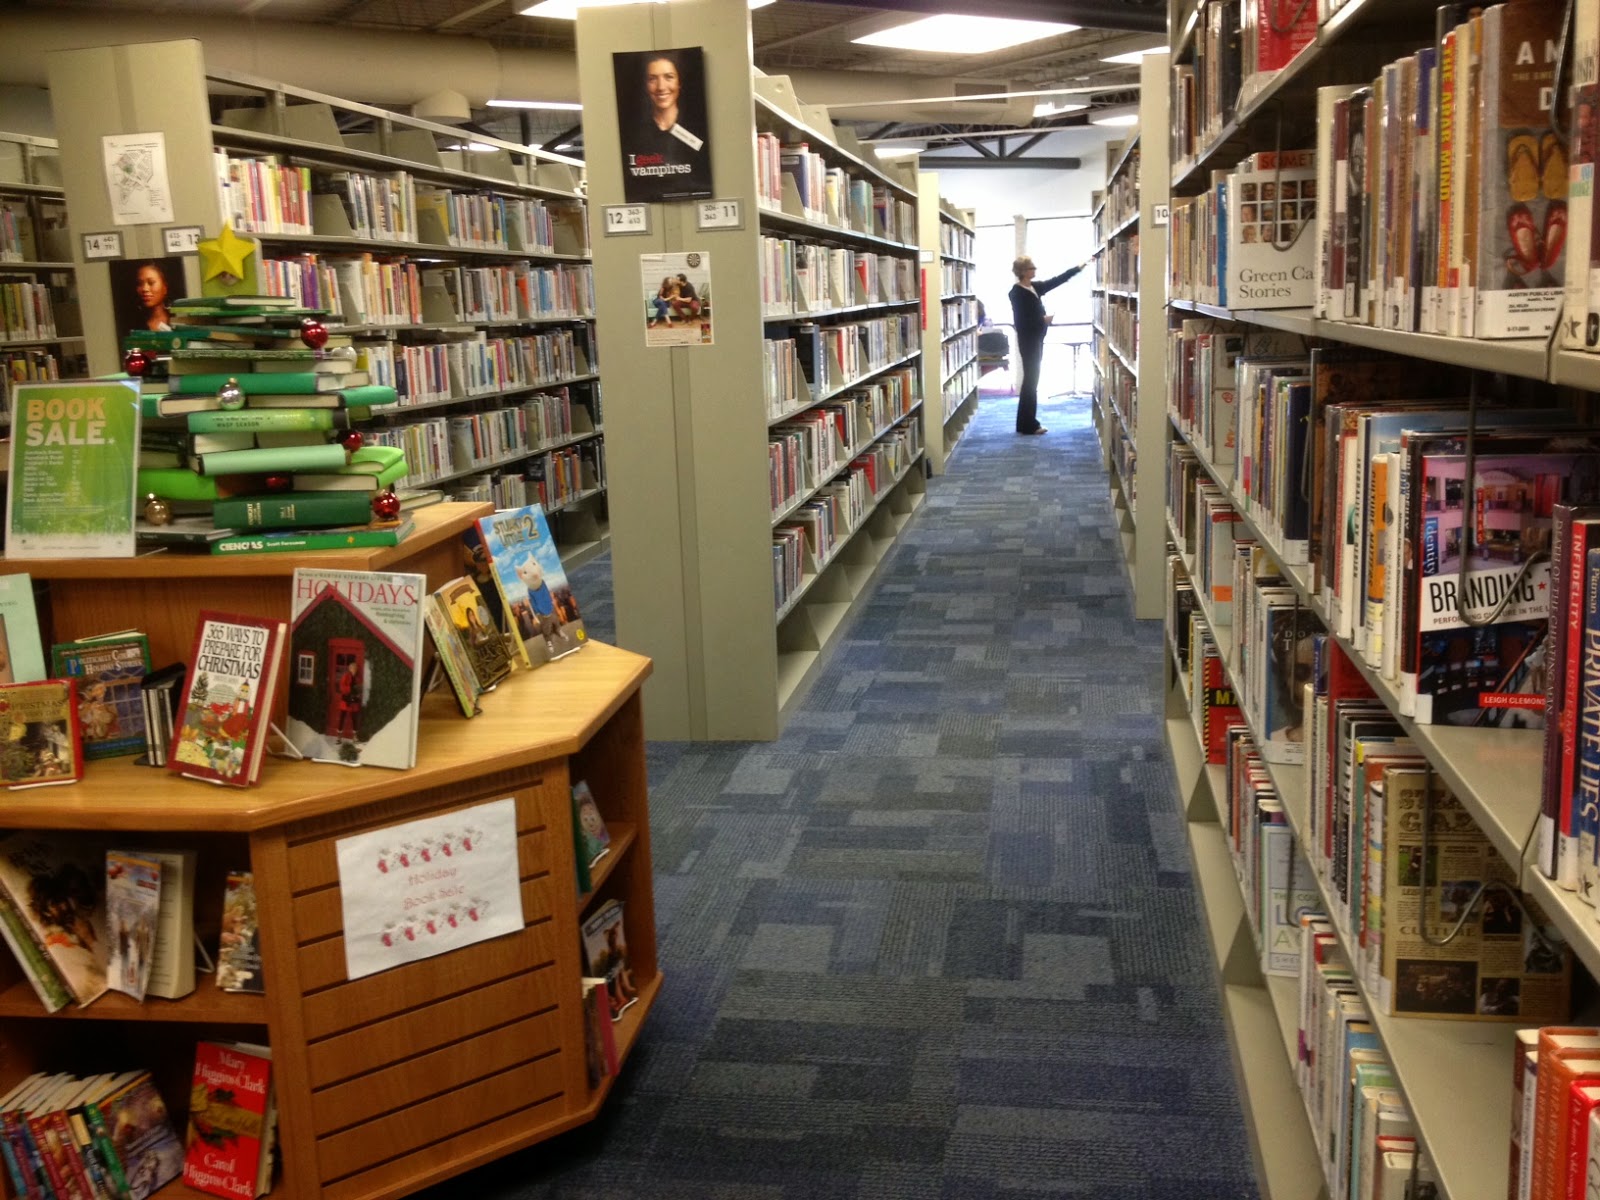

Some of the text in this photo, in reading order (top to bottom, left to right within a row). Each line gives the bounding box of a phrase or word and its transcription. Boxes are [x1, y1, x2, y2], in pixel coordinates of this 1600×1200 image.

[1441, 46, 1454, 201] THE ARAB MIND
[628, 154, 636, 165] I
[629, 163, 692, 177] vampires
[608, 212, 624, 224] 12
[723, 205, 737, 217] 11
[1157, 209, 1169, 218] 10
[87, 239, 100, 250] 14
[187, 233, 200, 245] 13
[1239, 268, 1288, 283] Green
[1239, 283, 1291, 299] Stories
[26, 398, 106, 421] BOOK
[523, 514, 539, 539] 2
[1425, 520, 1438, 574] Identity
[1553, 566, 1560, 582] OF
[297, 578, 417, 606] HOLIDAYS
[1430, 572, 1535, 613] BRANDING
[1529, 605, 1544, 614] THE
[207, 624, 264, 646] 365 WAYS TO
[1564, 534, 1582, 755] INFIDELITY LUSTERMAN
[202, 639, 261, 662] PREPARE FOR
[1548, 615, 1558, 681] CHEATING
[198, 655, 261, 680] CHRISTMAS
[1484, 696, 1507, 704] LEIGH
[1580, 628, 1600, 822] PRIVATE LIES
[219, 1052, 246, 1072] Mary
[195, 1062, 266, 1094] Higgins Clark
[204, 1153, 236, 1172] Carol
[183, 1163, 254, 1197] Higgins Clark
